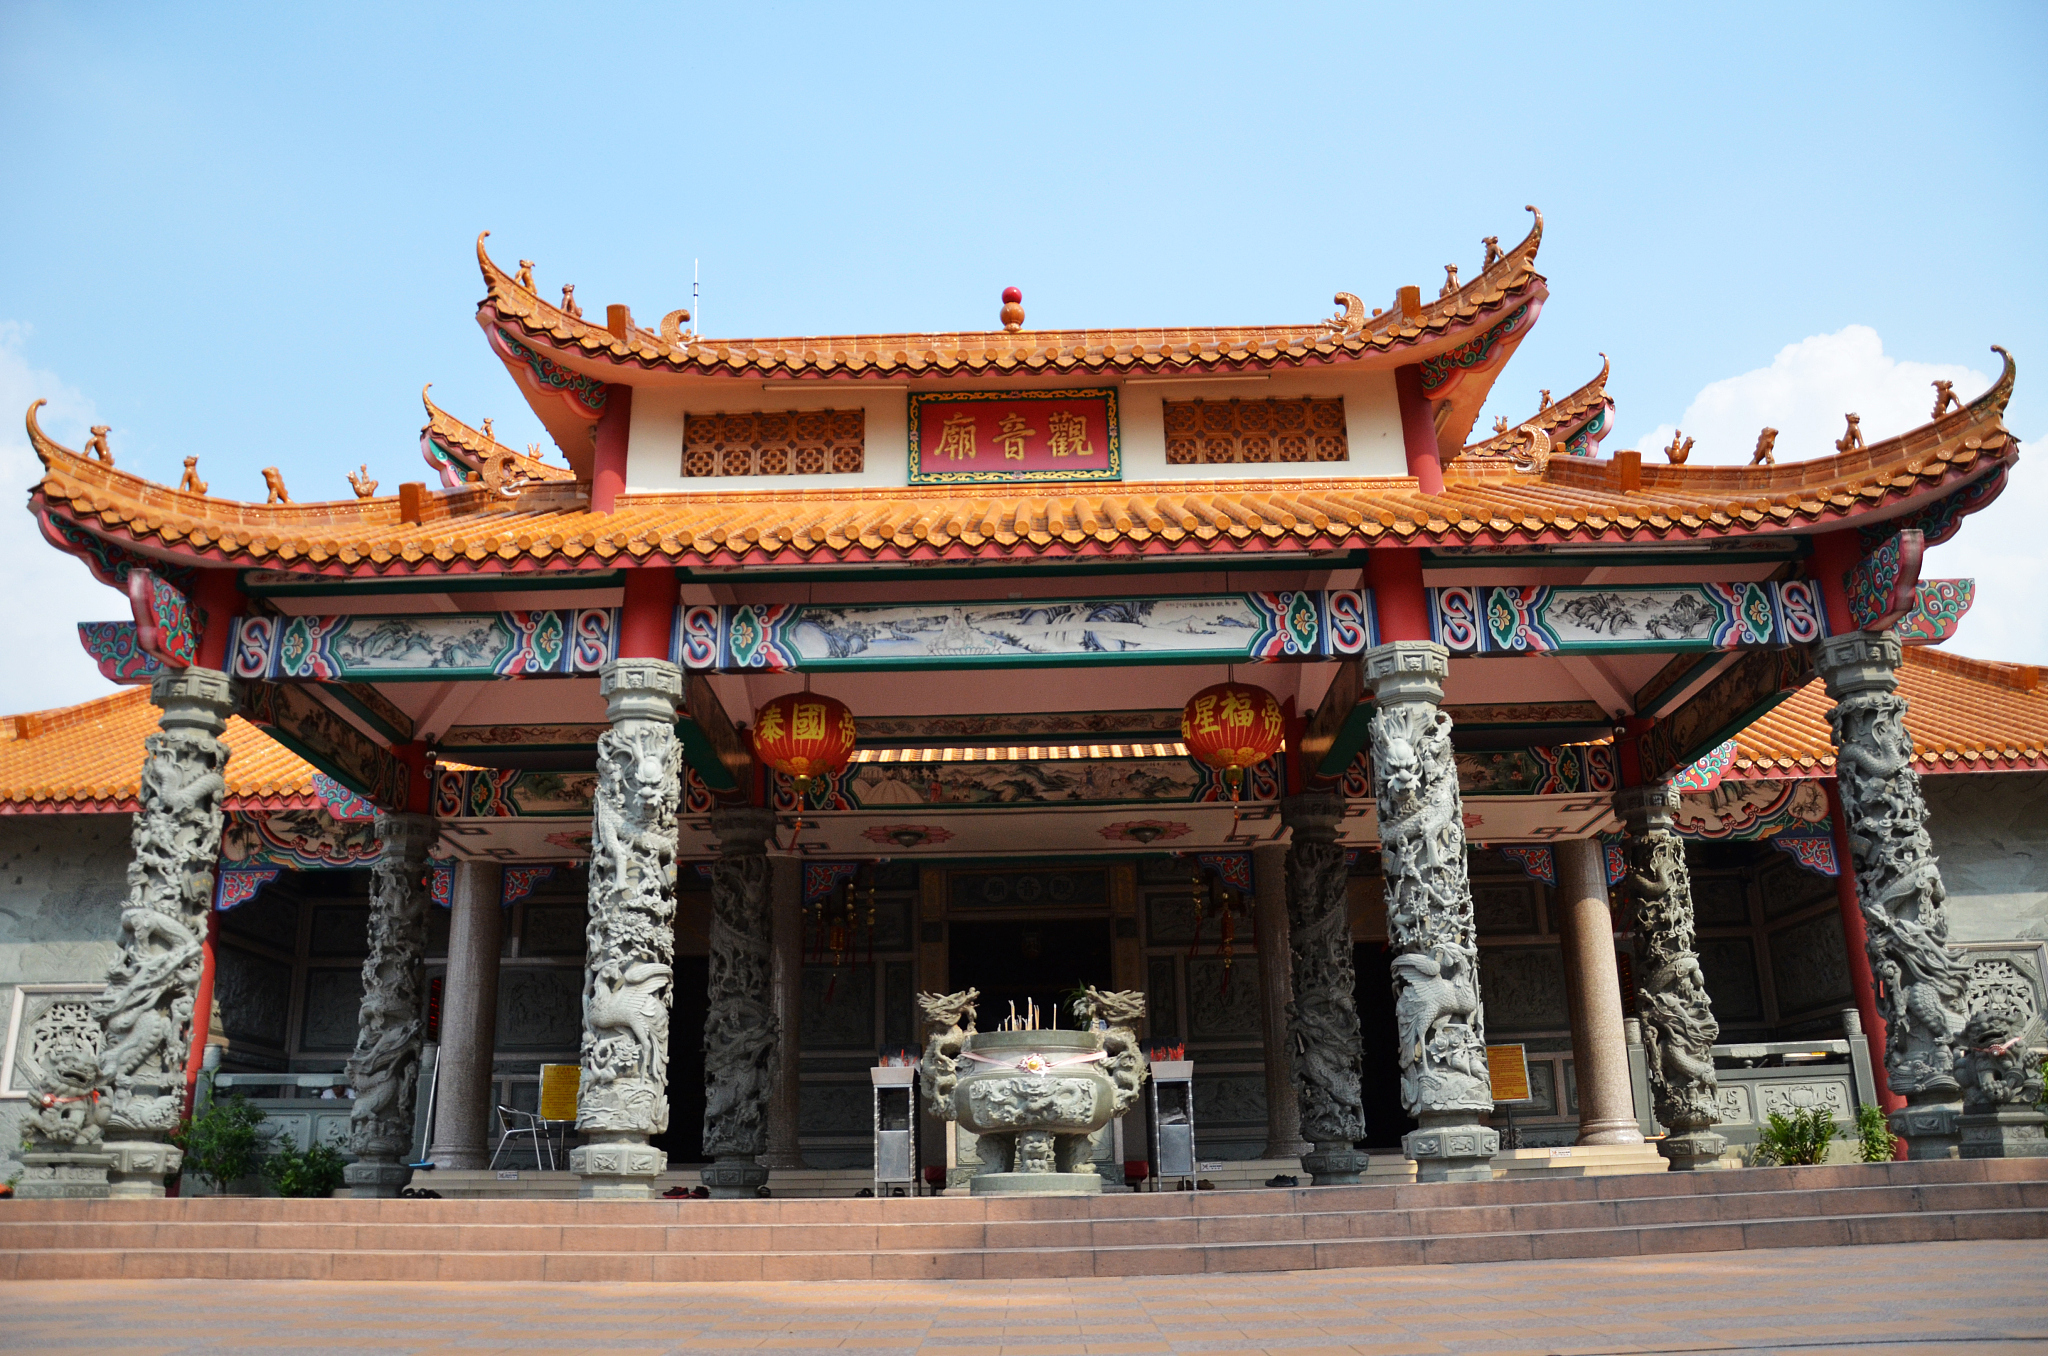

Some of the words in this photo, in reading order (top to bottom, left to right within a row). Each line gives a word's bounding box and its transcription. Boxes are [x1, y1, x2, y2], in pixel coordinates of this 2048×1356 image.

[933, 410, 1094, 461] 觀音廟
[754, 703, 827, 749] 國泰
